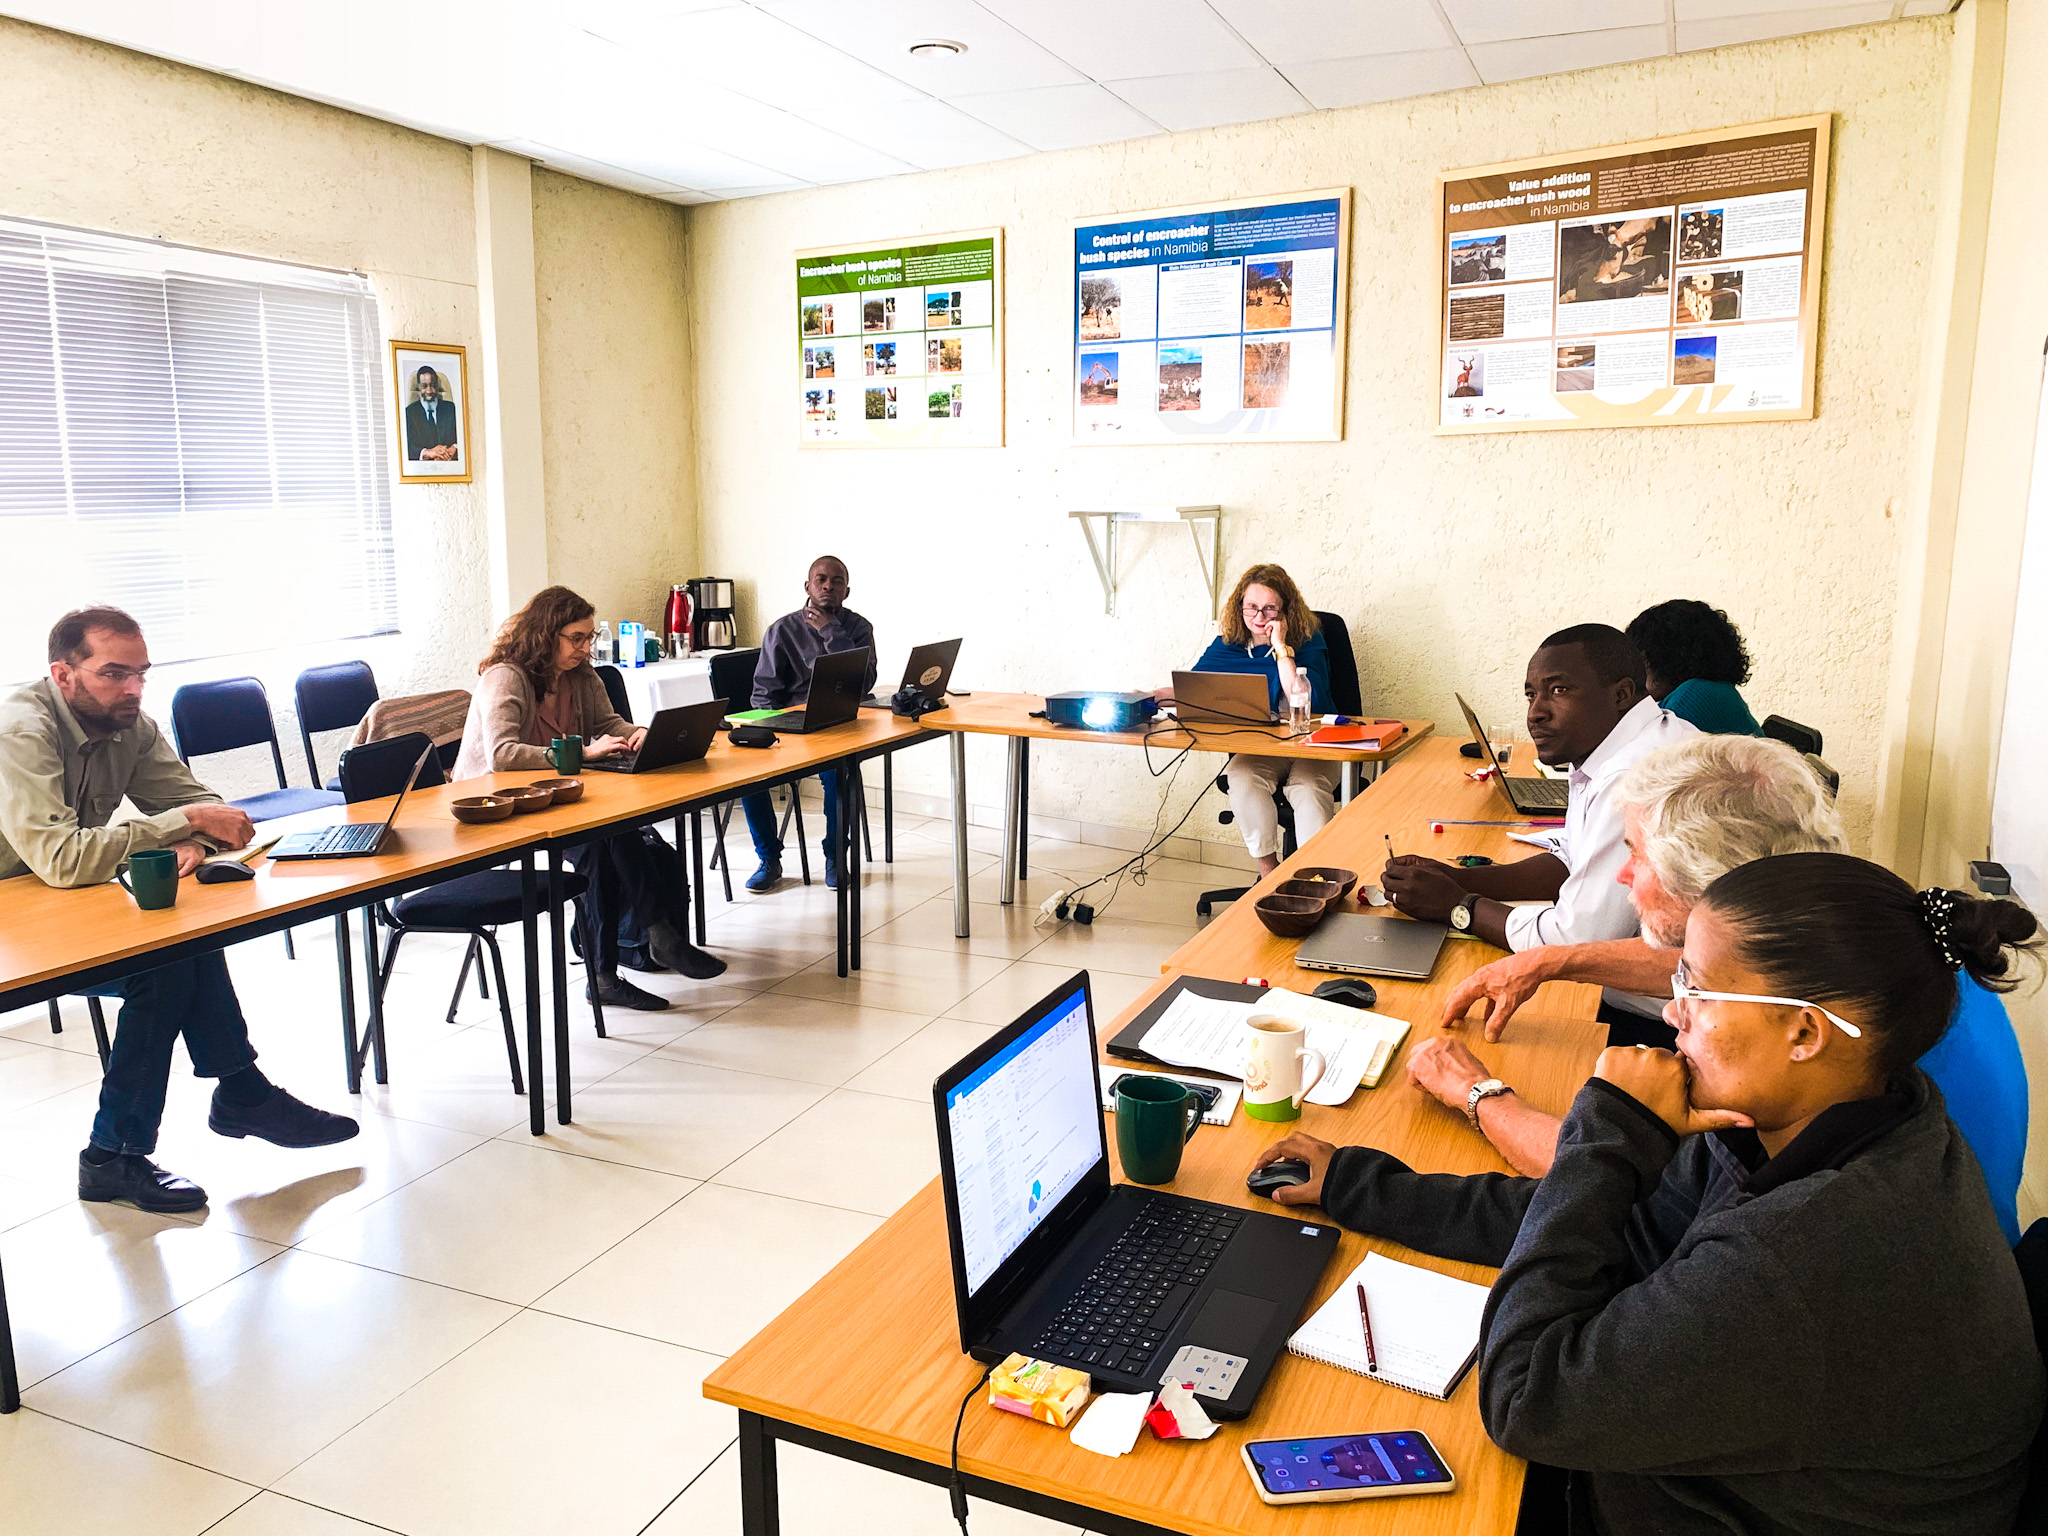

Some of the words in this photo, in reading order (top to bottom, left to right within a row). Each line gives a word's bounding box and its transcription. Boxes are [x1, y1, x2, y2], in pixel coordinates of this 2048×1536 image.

[1508, 178, 1540, 192] Value
[1542, 171, 1591, 187] addition
[1449, 203, 1461, 214] to
[1462, 195, 1527, 212] encroacher
[1526, 190, 1555, 204] bush
[1557, 185, 1591, 200] wood
[1530, 206, 1540, 217] in
[1543, 200, 1590, 216] Namibia
[1092, 231, 1131, 248] Control
[1132, 229, 1145, 244] of
[1145, 224, 1210, 243] encroacher
[1079, 250, 1106, 264] bush
[1107, 246, 1150, 263] species
[1151, 245, 1161, 257] in
[1164, 240, 1208, 256] Namibia
[799, 263, 846, 278] Encroacher
[845, 260, 867, 273] bush
[867, 257, 902, 272] species
[857, 273, 866, 286] of
[867, 271, 902, 285] Namibia
